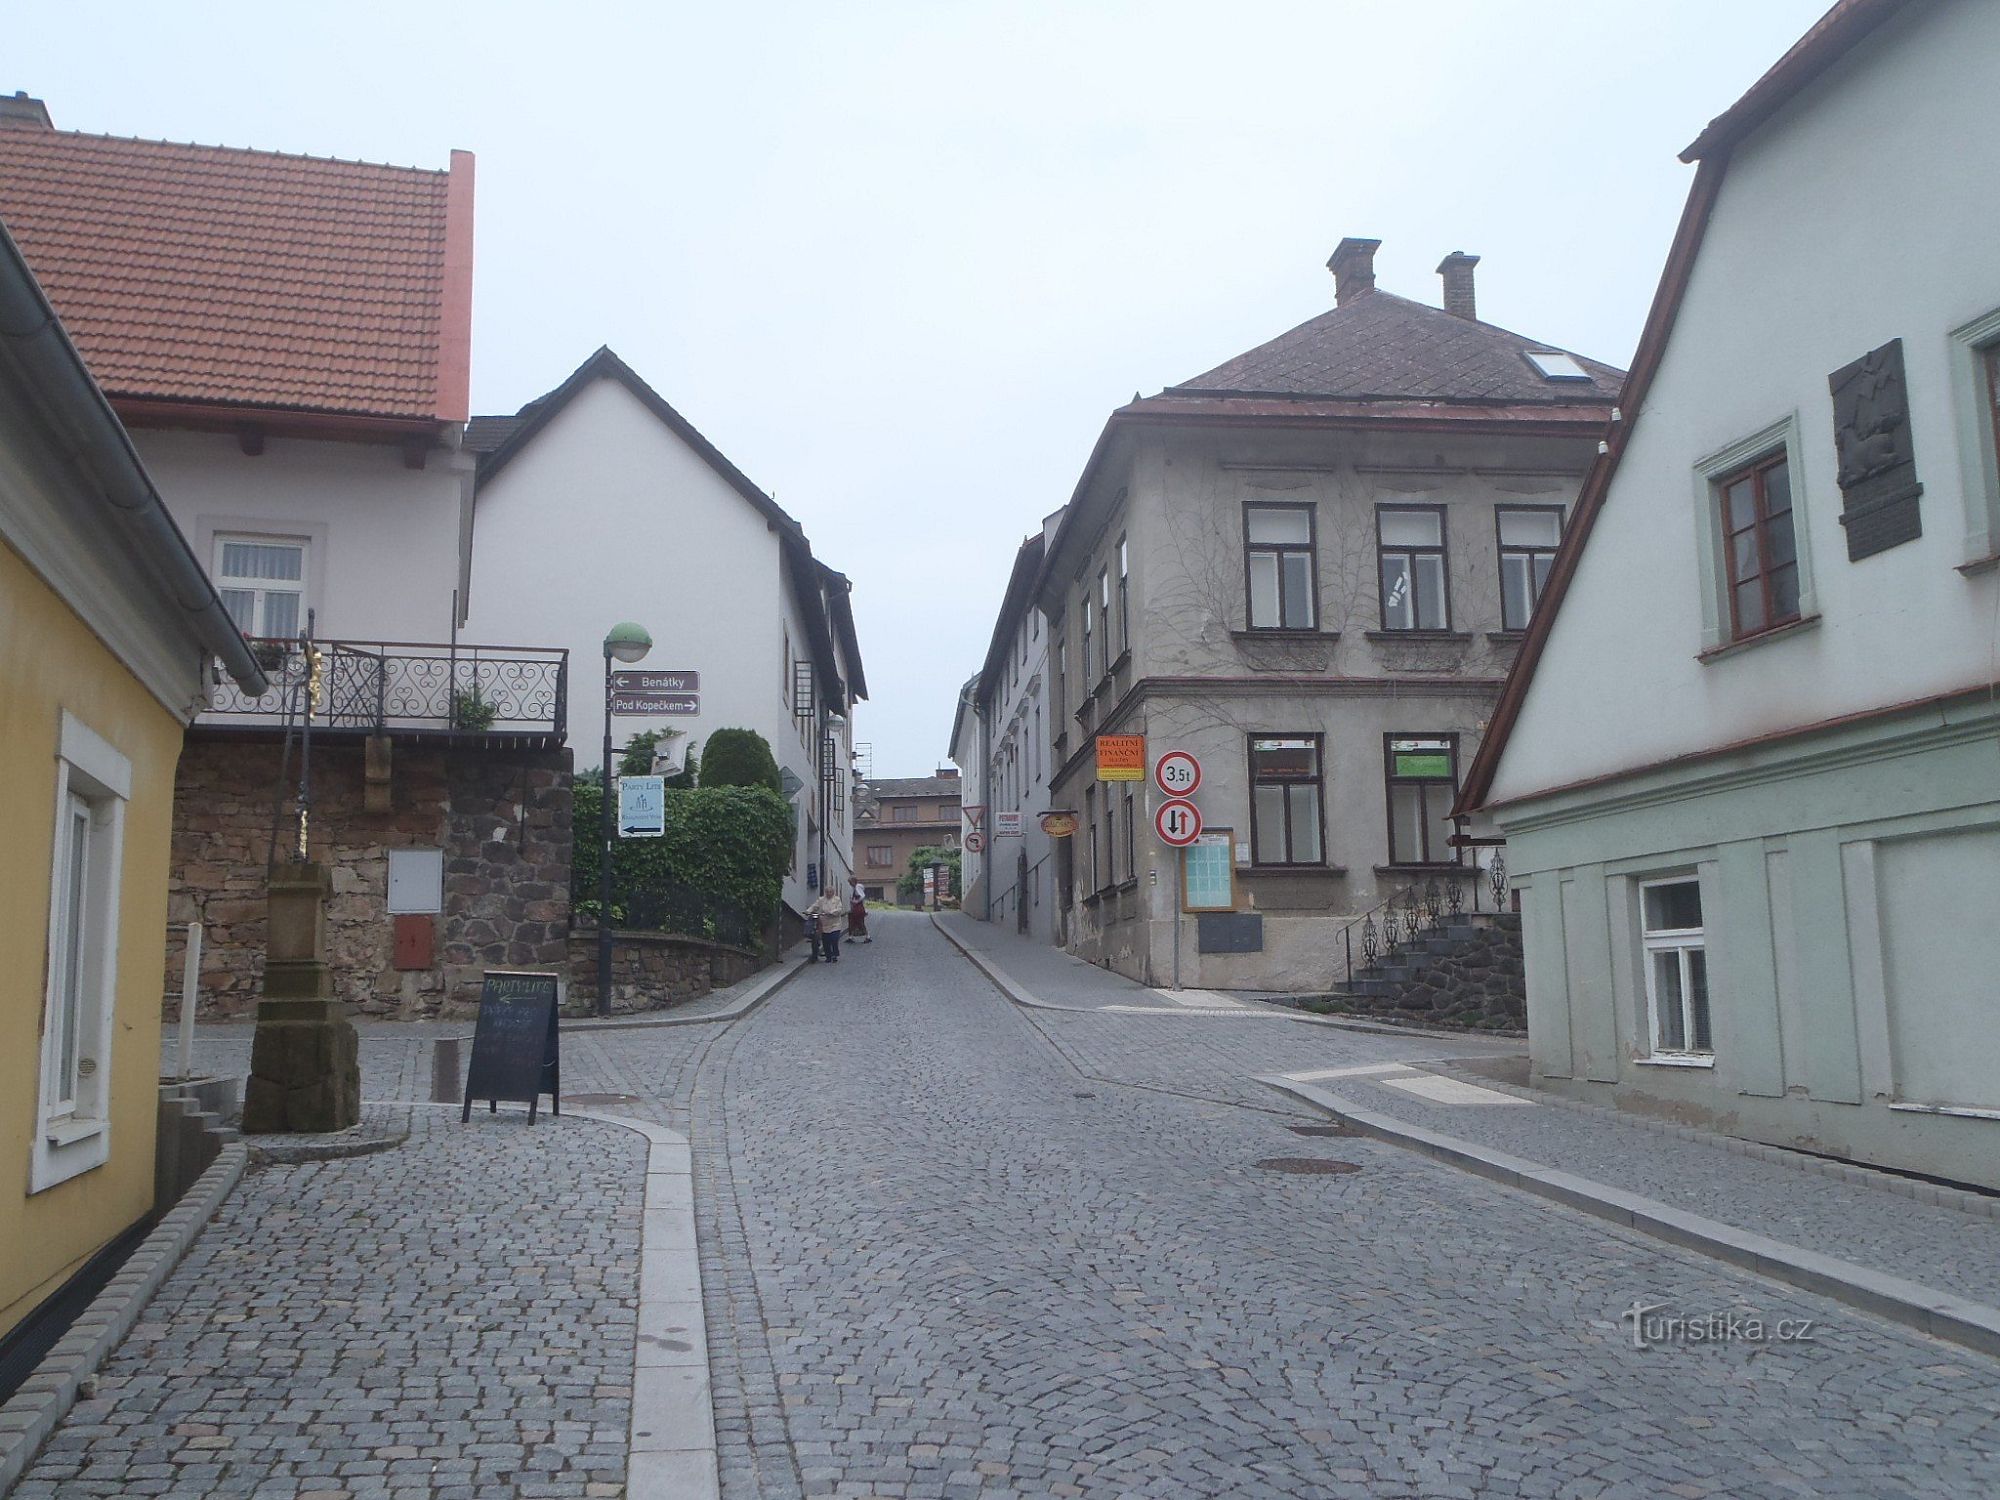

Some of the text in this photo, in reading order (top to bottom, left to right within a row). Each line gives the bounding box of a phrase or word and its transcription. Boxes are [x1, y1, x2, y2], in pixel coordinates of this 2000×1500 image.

[642, 677, 684, 689] Benátky
[616, 699, 684, 712] Pod Kopečkem
